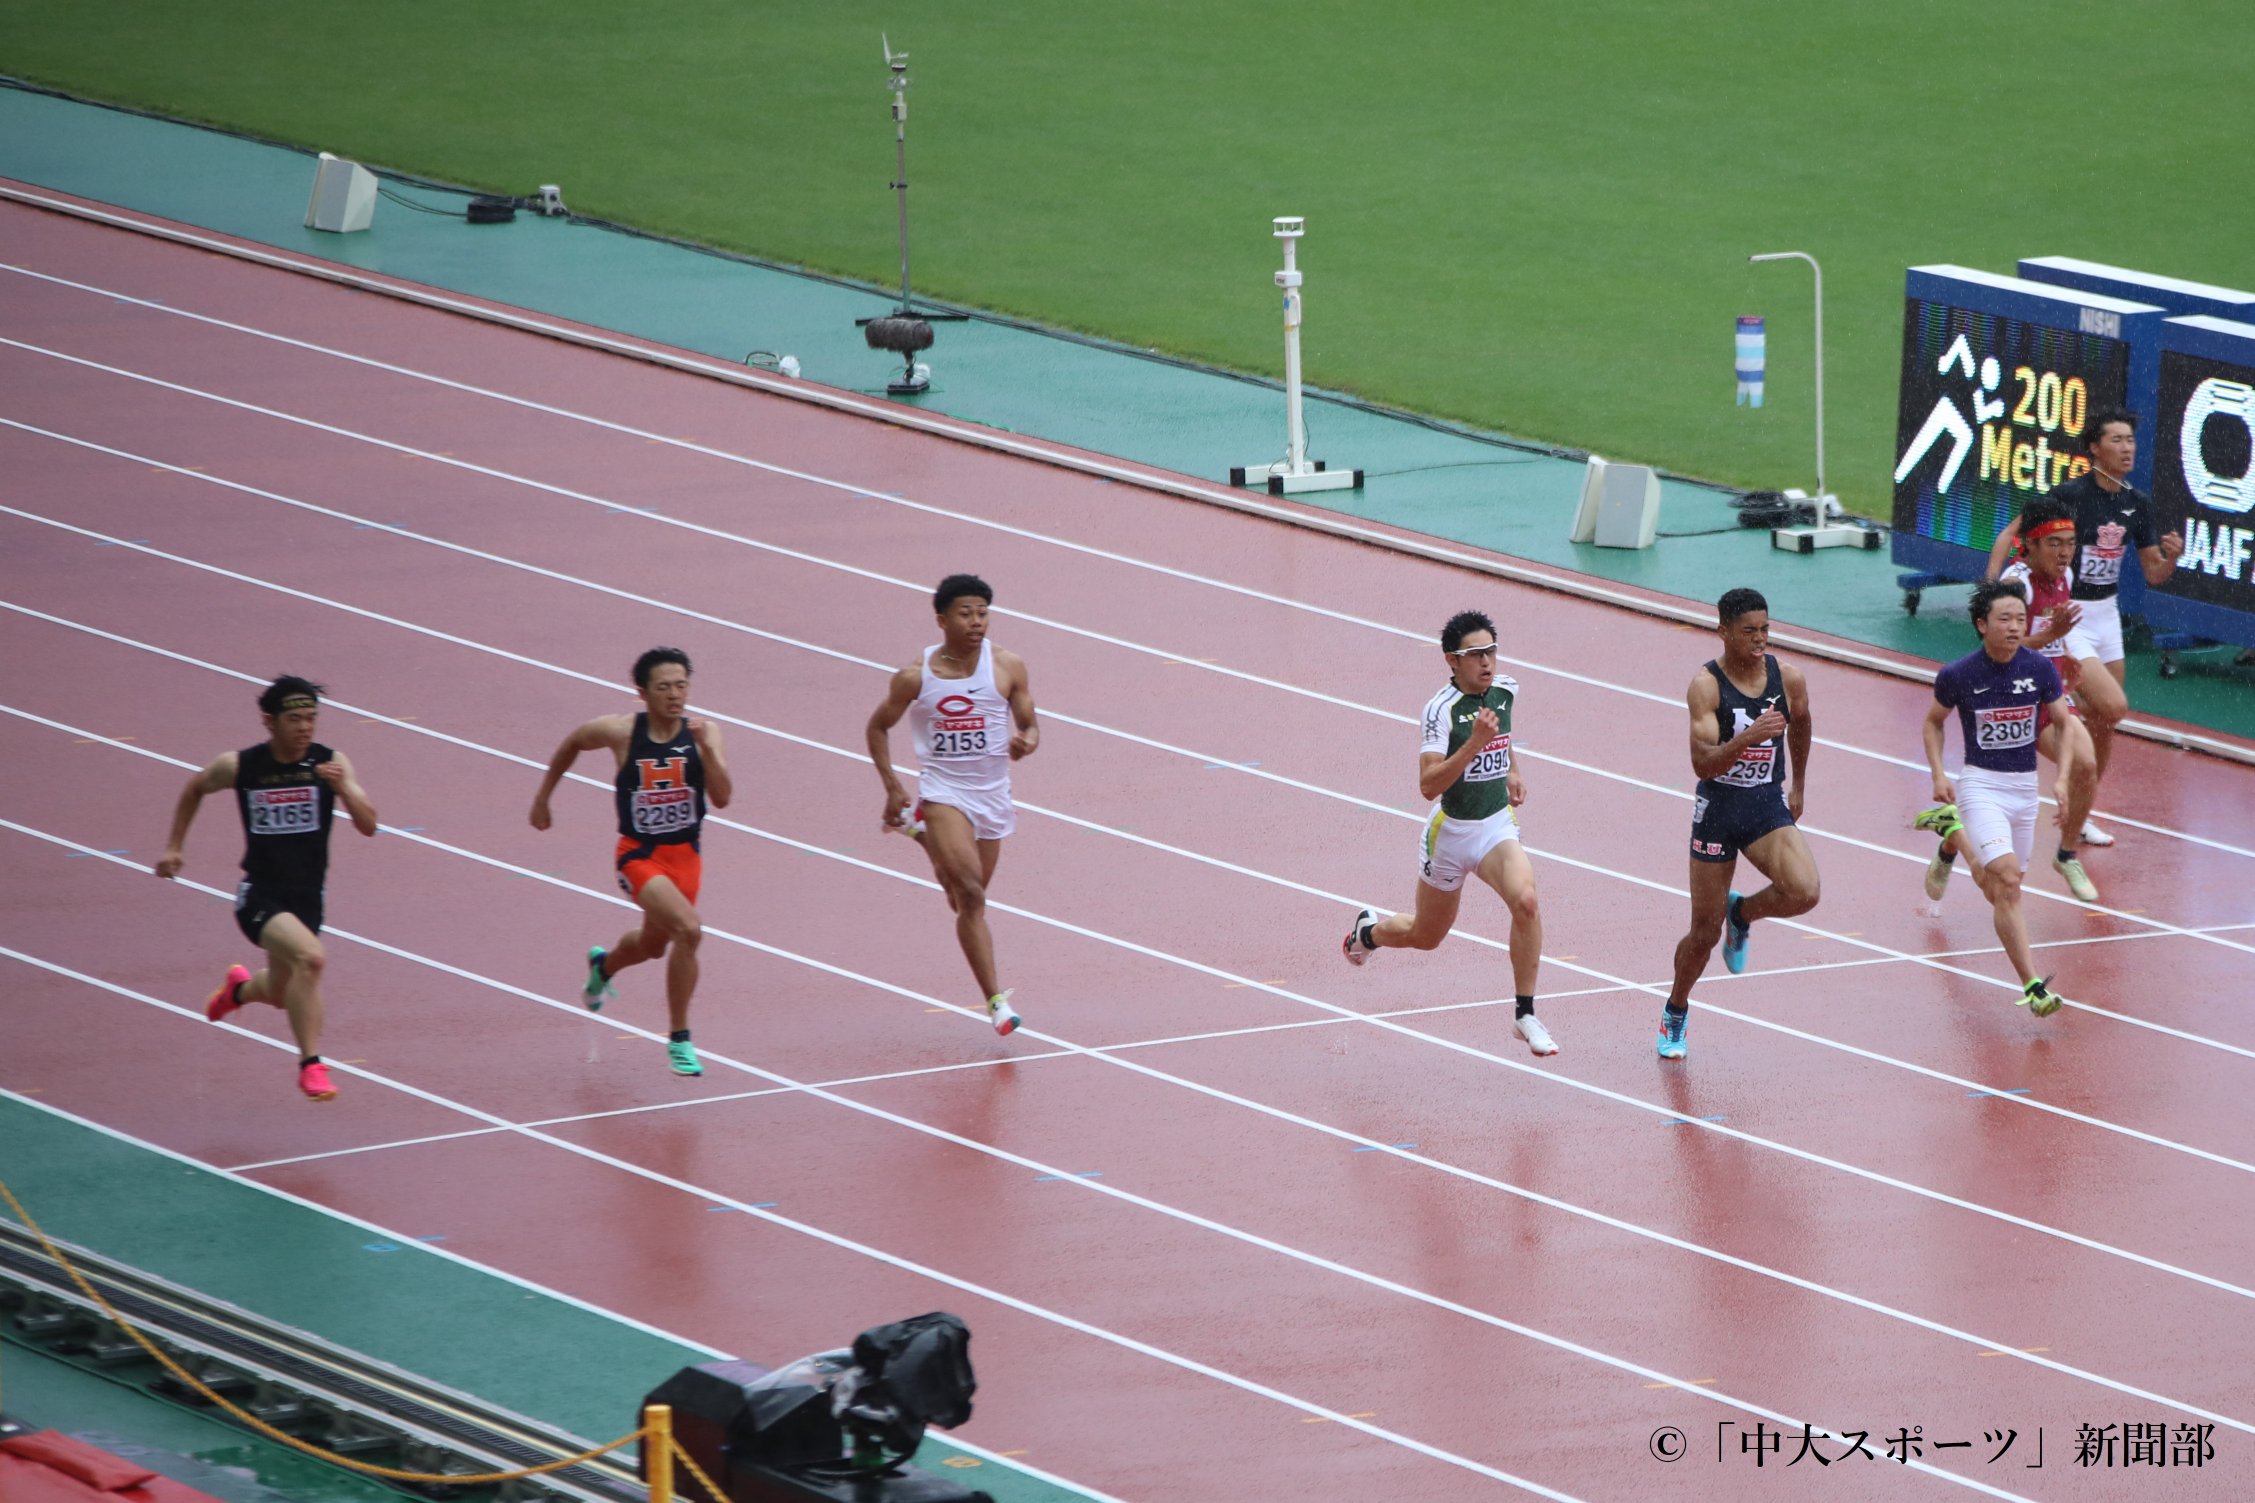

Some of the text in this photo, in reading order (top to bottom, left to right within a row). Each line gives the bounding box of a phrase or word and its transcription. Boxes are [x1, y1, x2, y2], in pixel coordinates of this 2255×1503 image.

[2081, 307, 2120, 338] NISHI
[2013, 365, 2087, 437] 200
[2176, 516, 2254, 579] JAAF
[2012, 678, 2037, 694] M
[934, 731, 986, 752] 2153
[1982, 719, 2032, 742] 2306
[635, 757, 688, 790] H
[1726, 760, 1770, 779] 259
[256, 803, 313, 827] 2165
[636, 802, 690, 827] 2289
